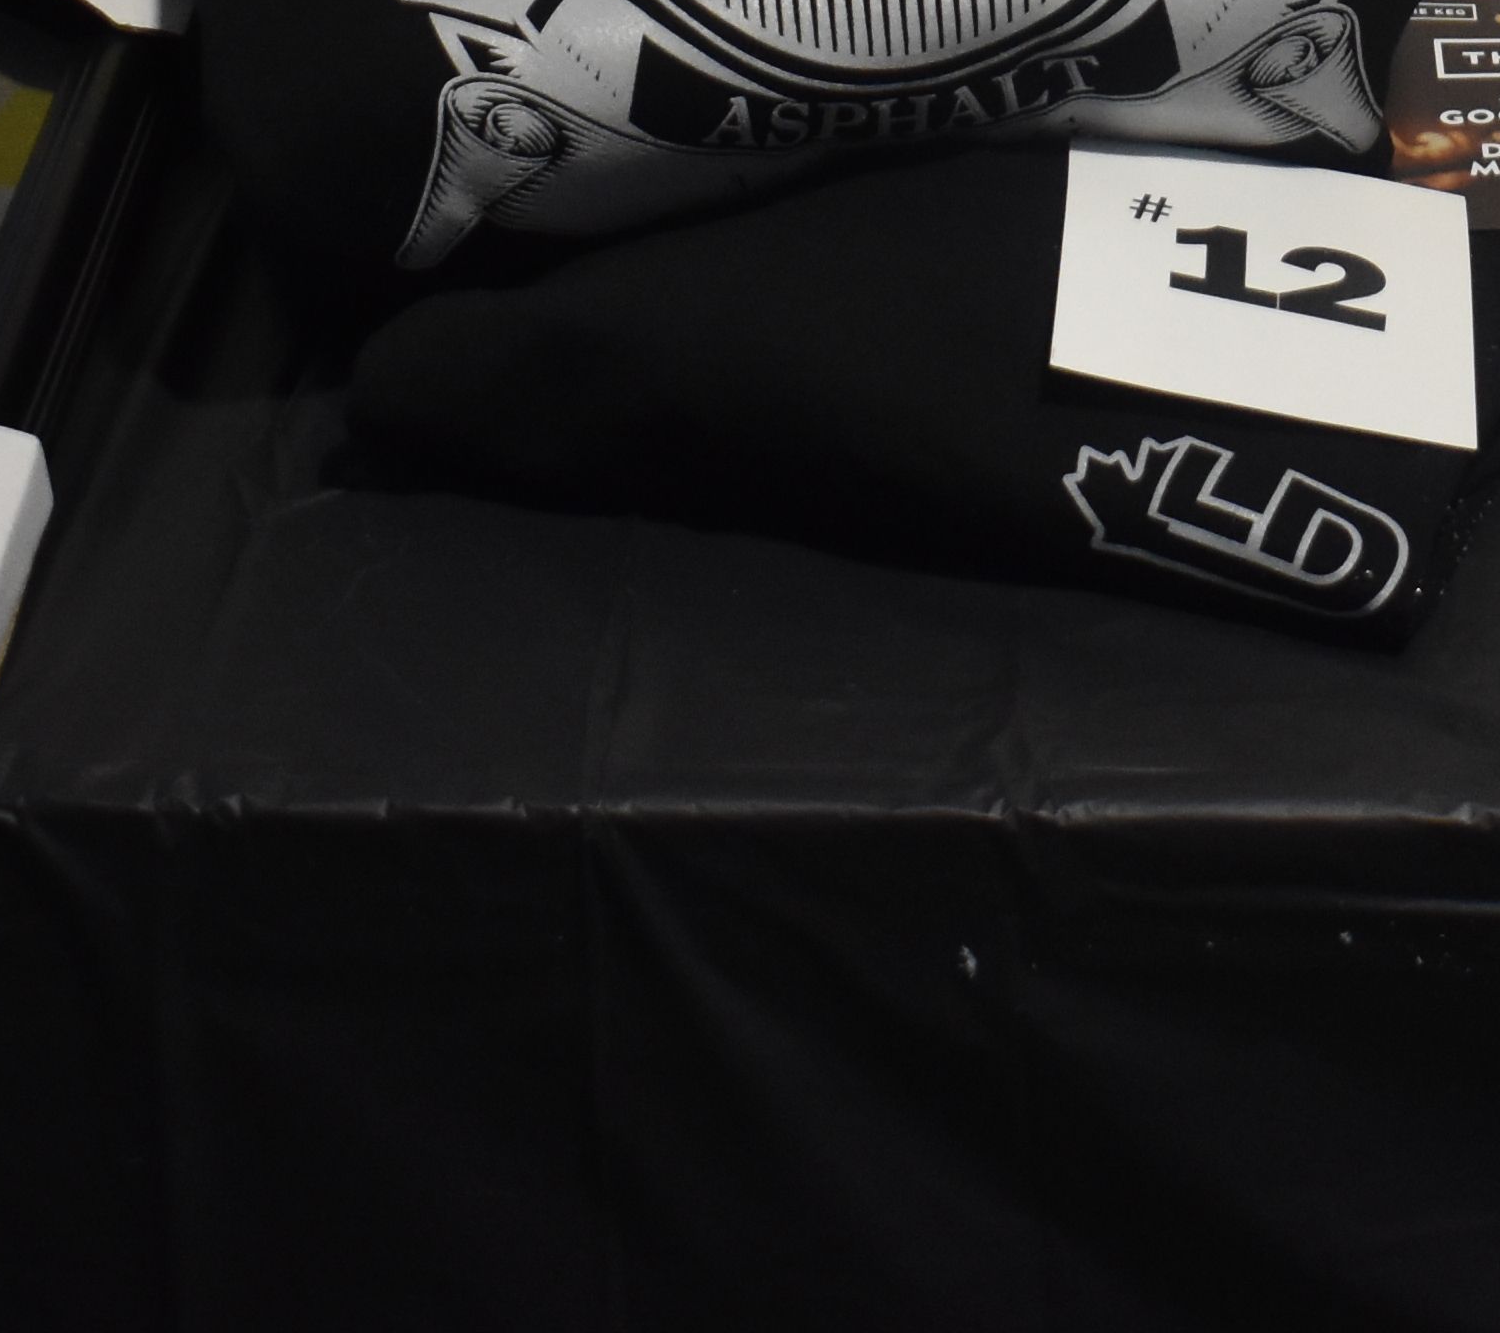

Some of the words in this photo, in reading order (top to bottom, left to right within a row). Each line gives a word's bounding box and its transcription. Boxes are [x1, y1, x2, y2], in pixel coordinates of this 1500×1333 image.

[1434, 7, 1466, 16] KEG
[701, 54, 1100, 147] ASPHALT
[1129, 190, 1388, 333] #12
